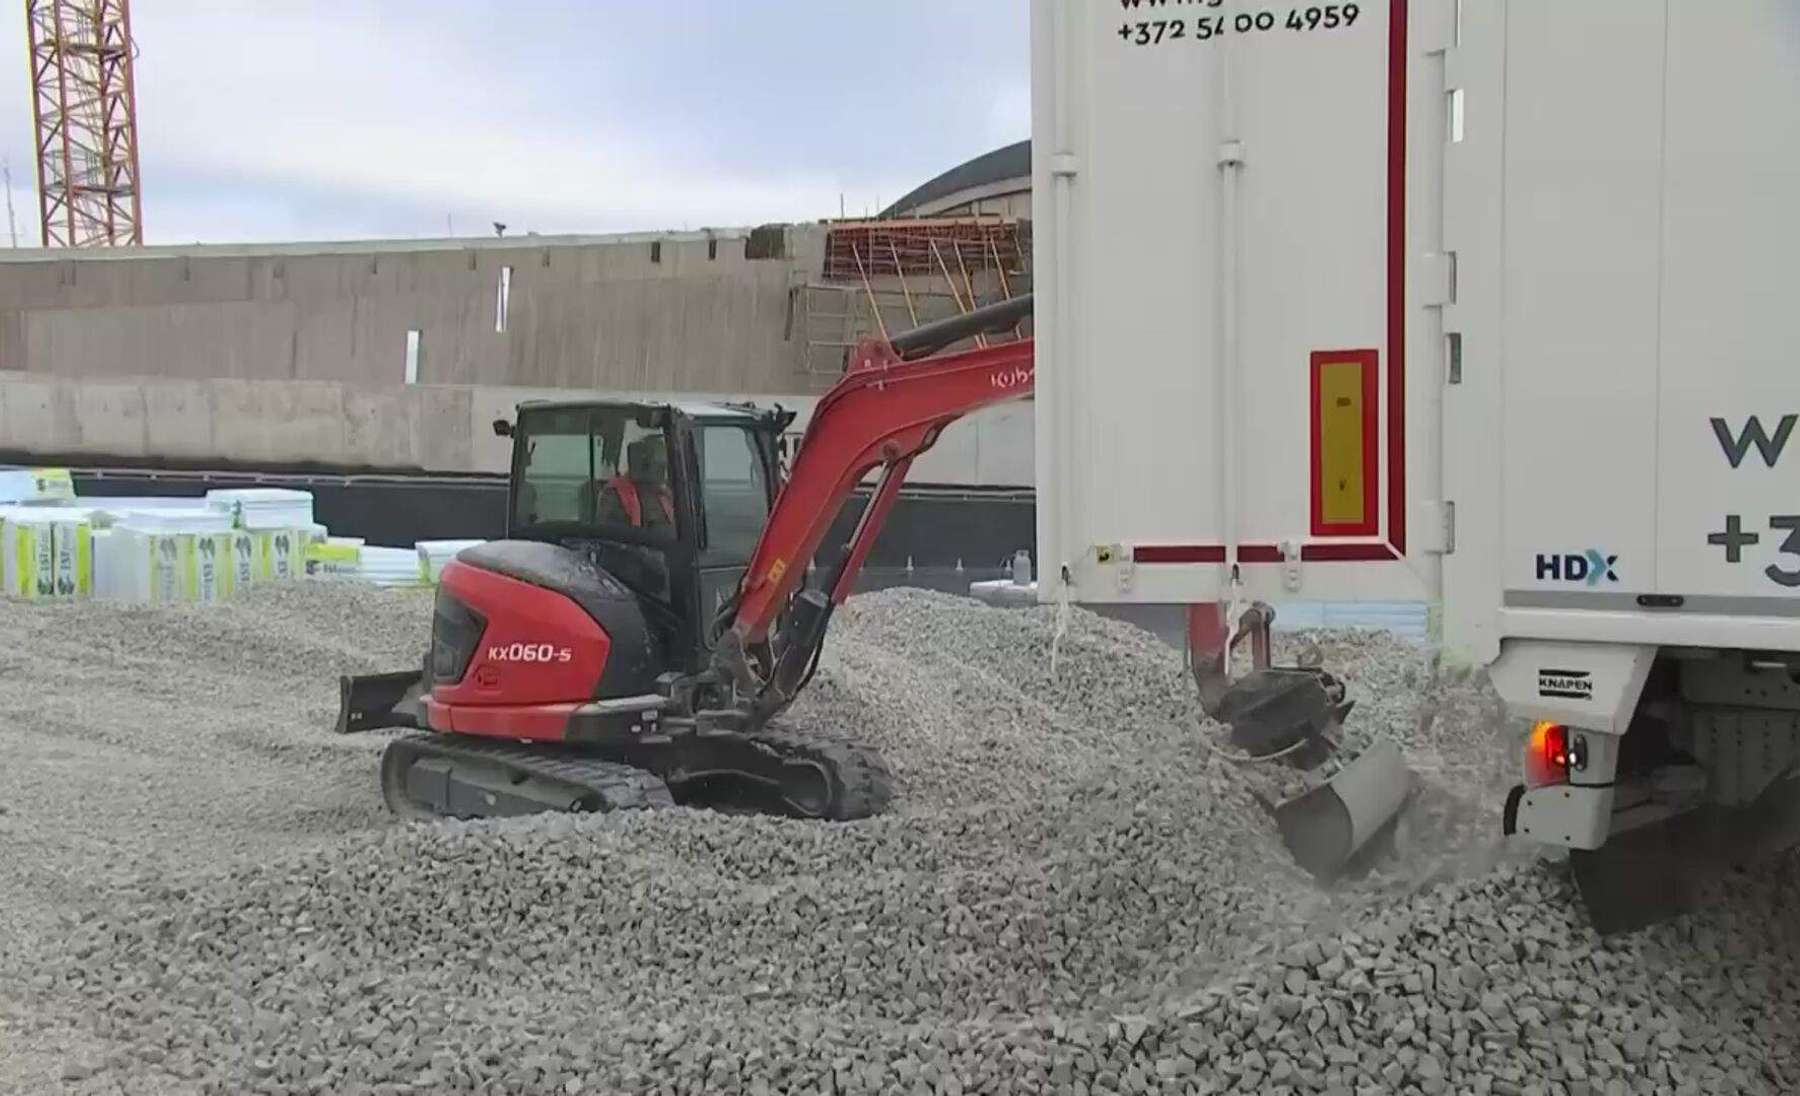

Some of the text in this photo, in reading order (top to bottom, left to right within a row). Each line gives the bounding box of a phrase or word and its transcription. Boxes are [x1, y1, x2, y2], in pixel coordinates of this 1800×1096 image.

[1118, 19, 1186, 45] +372
[1235, 12, 1275, 33] 00
[1285, 3, 1360, 31] 4959
[1536, 549, 1619, 586] HDX
[1539, 678, 1593, 690] KNAPEN
